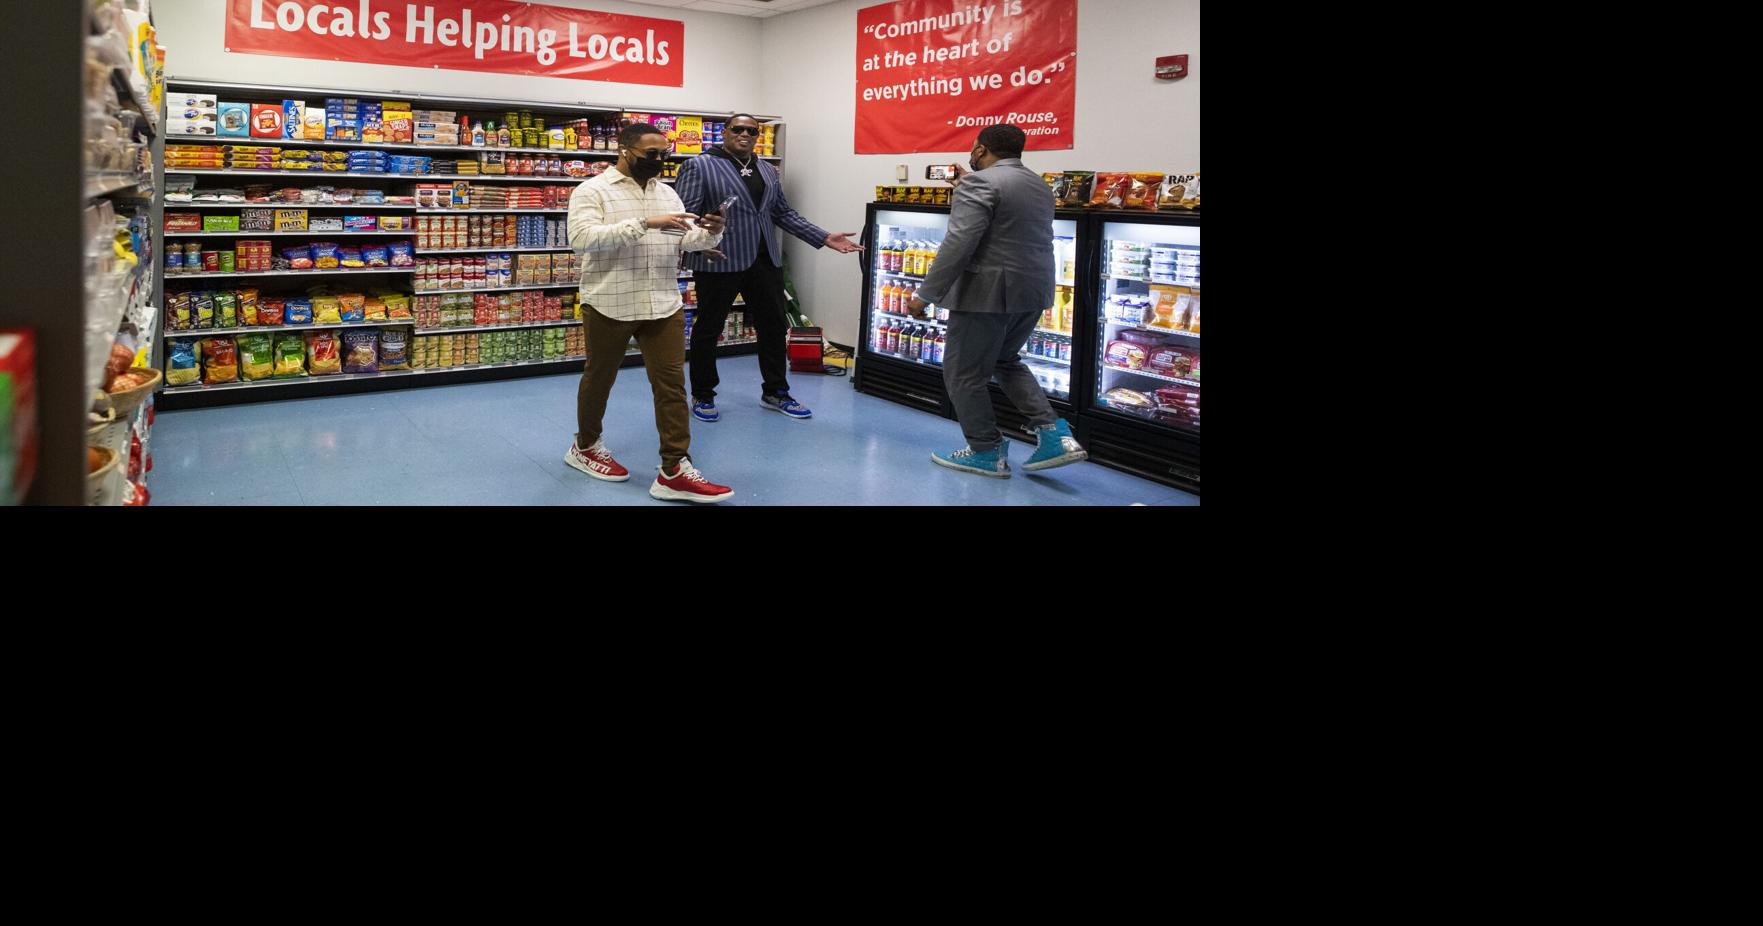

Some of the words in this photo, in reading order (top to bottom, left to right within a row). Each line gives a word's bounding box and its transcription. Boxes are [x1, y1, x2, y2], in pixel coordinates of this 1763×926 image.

[1003, 0, 1023, 17] is
[249, 0, 392, 41] Locals
[405, 3, 557, 66] Helping
[568, 21, 671, 66] Locals
[863, 54, 880, 71] at
[884, 50, 916, 68] the
[922, 40, 980, 63] heart
[986, 32, 1012, 53] of
[863, 77, 962, 101] everything
[969, 73, 1003, 91] we
[955, 114, 1003, 127] Donny
[1005, 111, 1058, 125] Rouse,
[1021, 126, 1060, 137] eration
[1168, 175, 1195, 185] RAP
